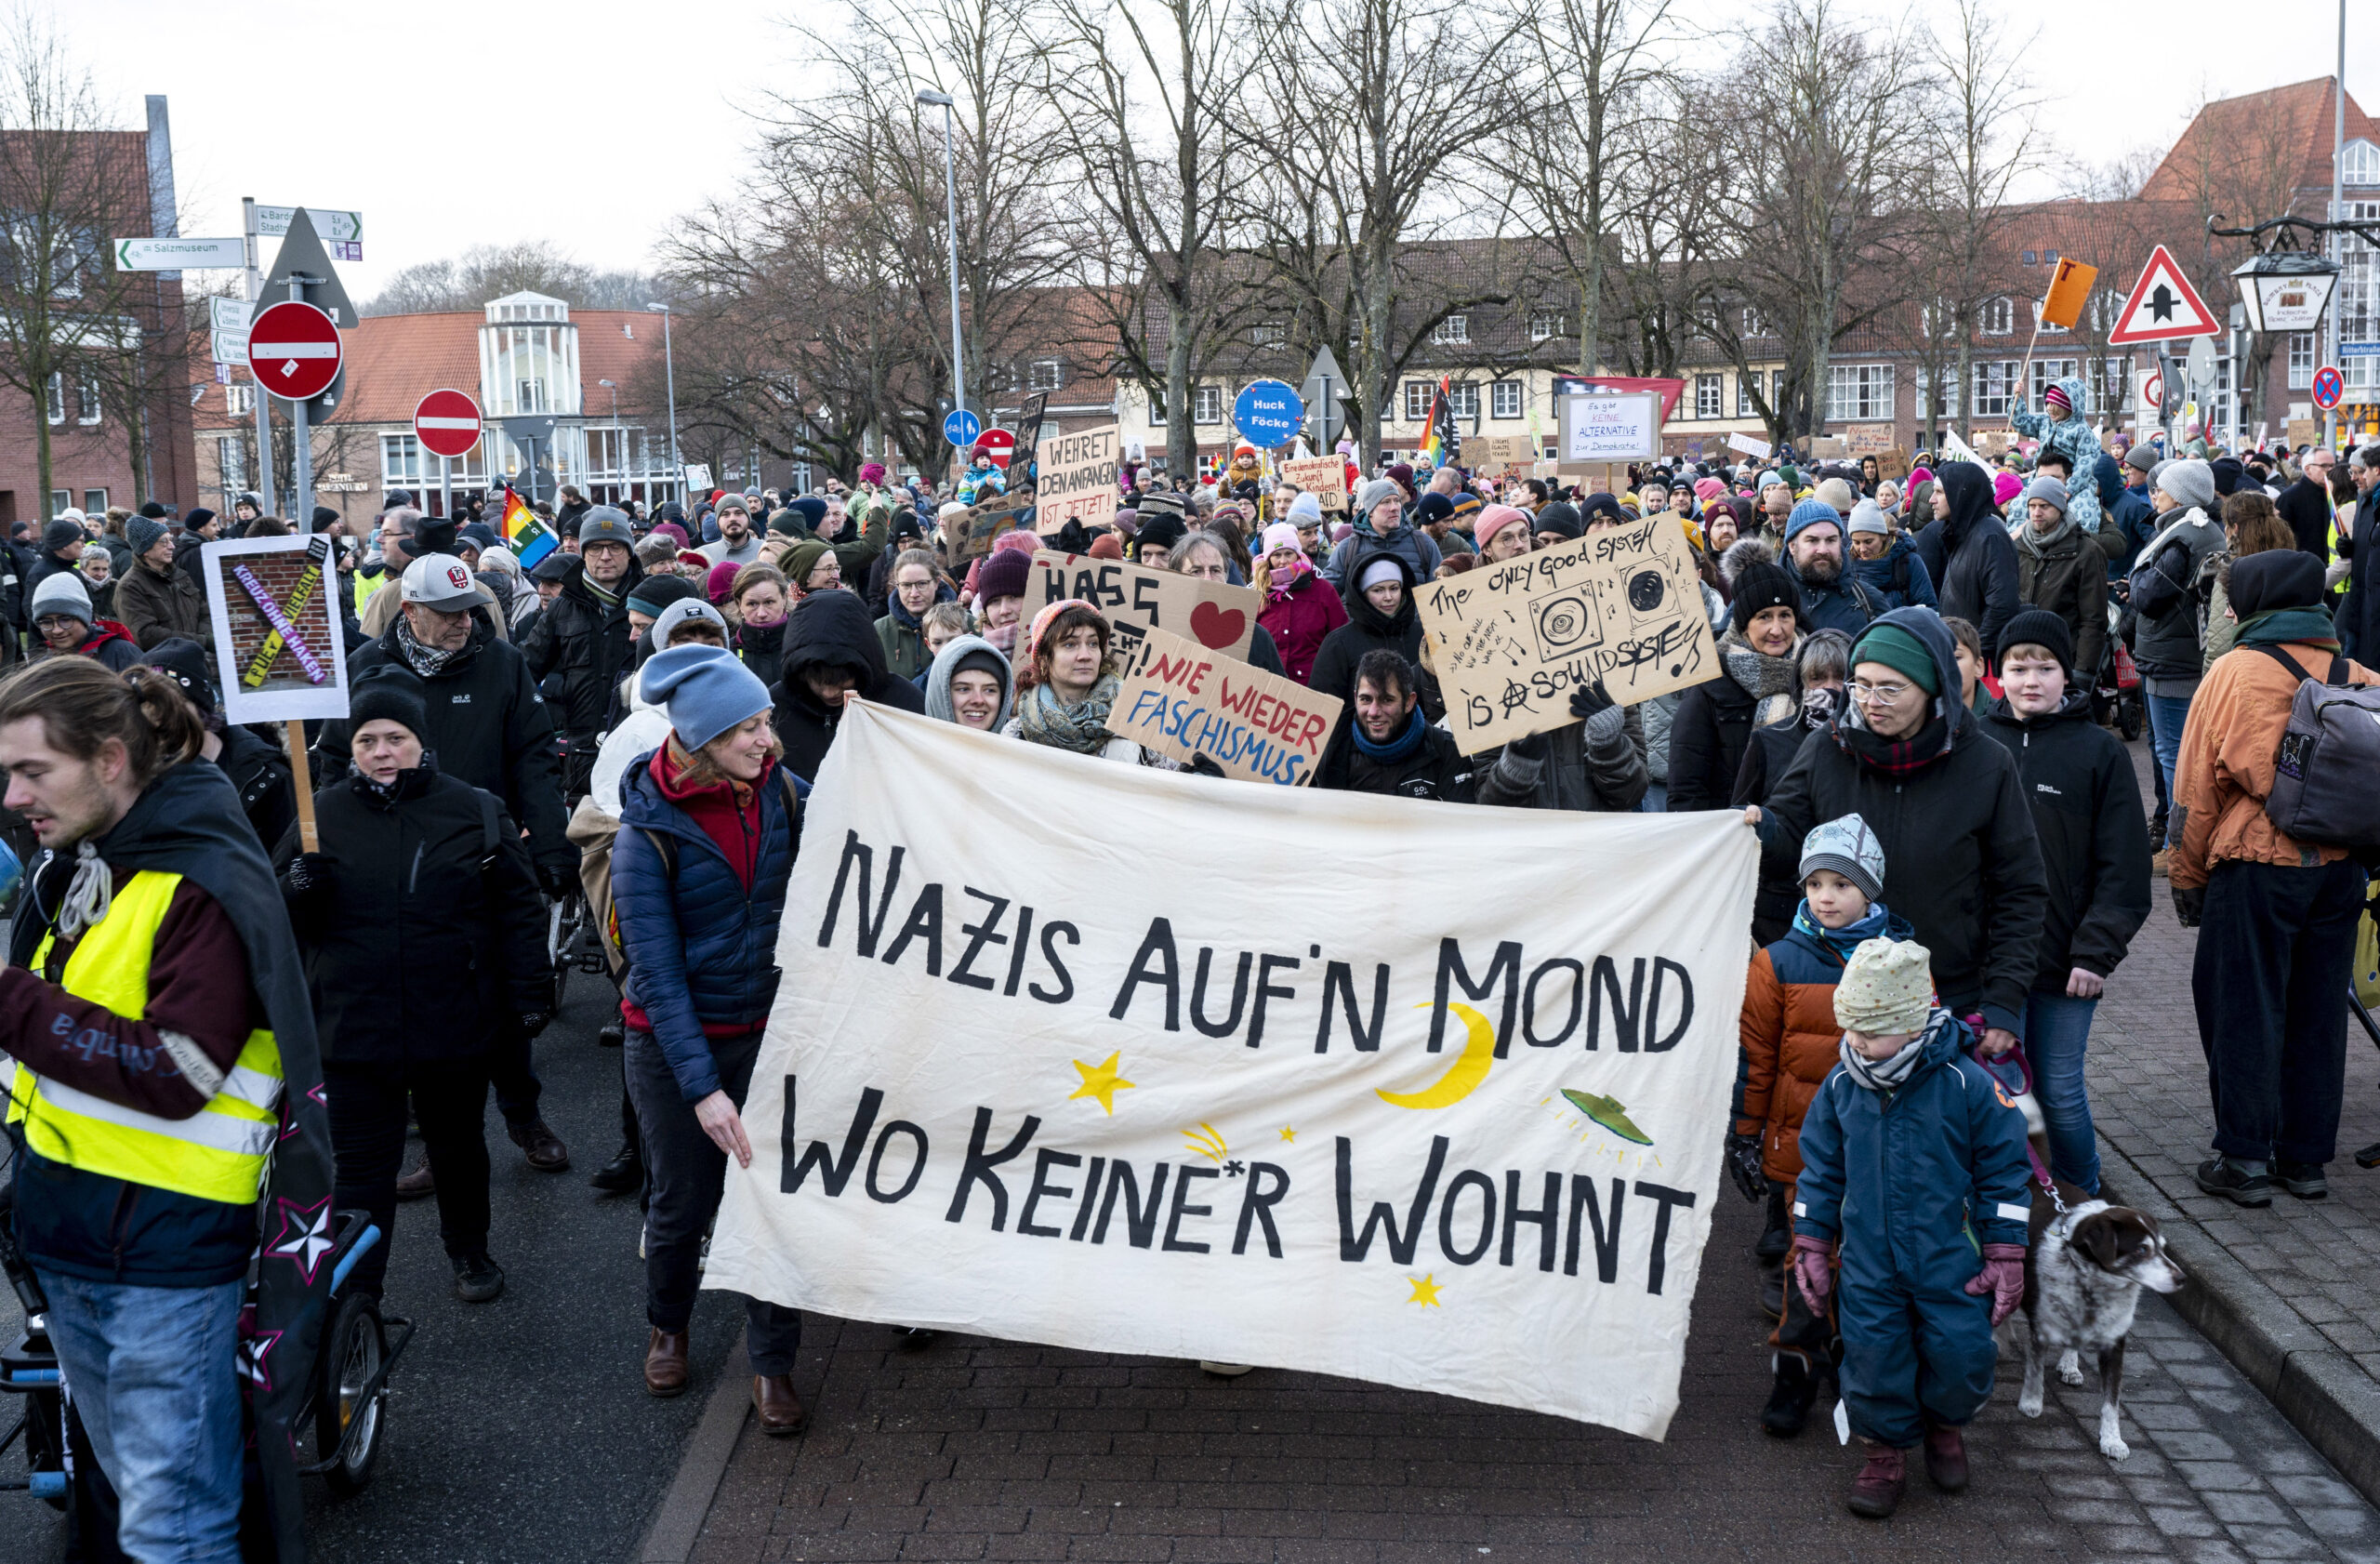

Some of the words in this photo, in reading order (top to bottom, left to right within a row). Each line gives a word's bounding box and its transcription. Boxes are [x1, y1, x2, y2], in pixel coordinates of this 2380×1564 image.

[154, 243, 218, 254] Salzmuseum
[1251, 416, 1289, 429] Föcke
[1253, 400, 1286, 410] Huck
[1592, 414, 1620, 422] KEINE
[1050, 431, 1116, 466] WEHRET
[1579, 426, 1638, 437] ALTERNATIVE
[1039, 471, 1068, 497] DEN
[1069, 459, 1118, 492] ANFÄNGEN
[1295, 470, 1323, 484] Zukunft
[1042, 503, 1060, 528] IST
[1430, 585, 1474, 621] The
[1488, 562, 1534, 595] ONLY
[1595, 521, 1658, 563] SYSTEM
[284, 566, 320, 621] VIELFALT
[233, 563, 268, 605] KREUZ
[262, 601, 293, 639] OHNE
[286, 634, 325, 683] HAKEN
[1221, 676, 1327, 756] WIEDER
[817, 828, 1081, 1004] NAZIS
[1109, 916, 1390, 1054] AUF'N
[1426, 937, 1695, 1060] MOND
[781, 1075, 929, 1204] WO
[1336, 1134, 1697, 1296] WOHNT
